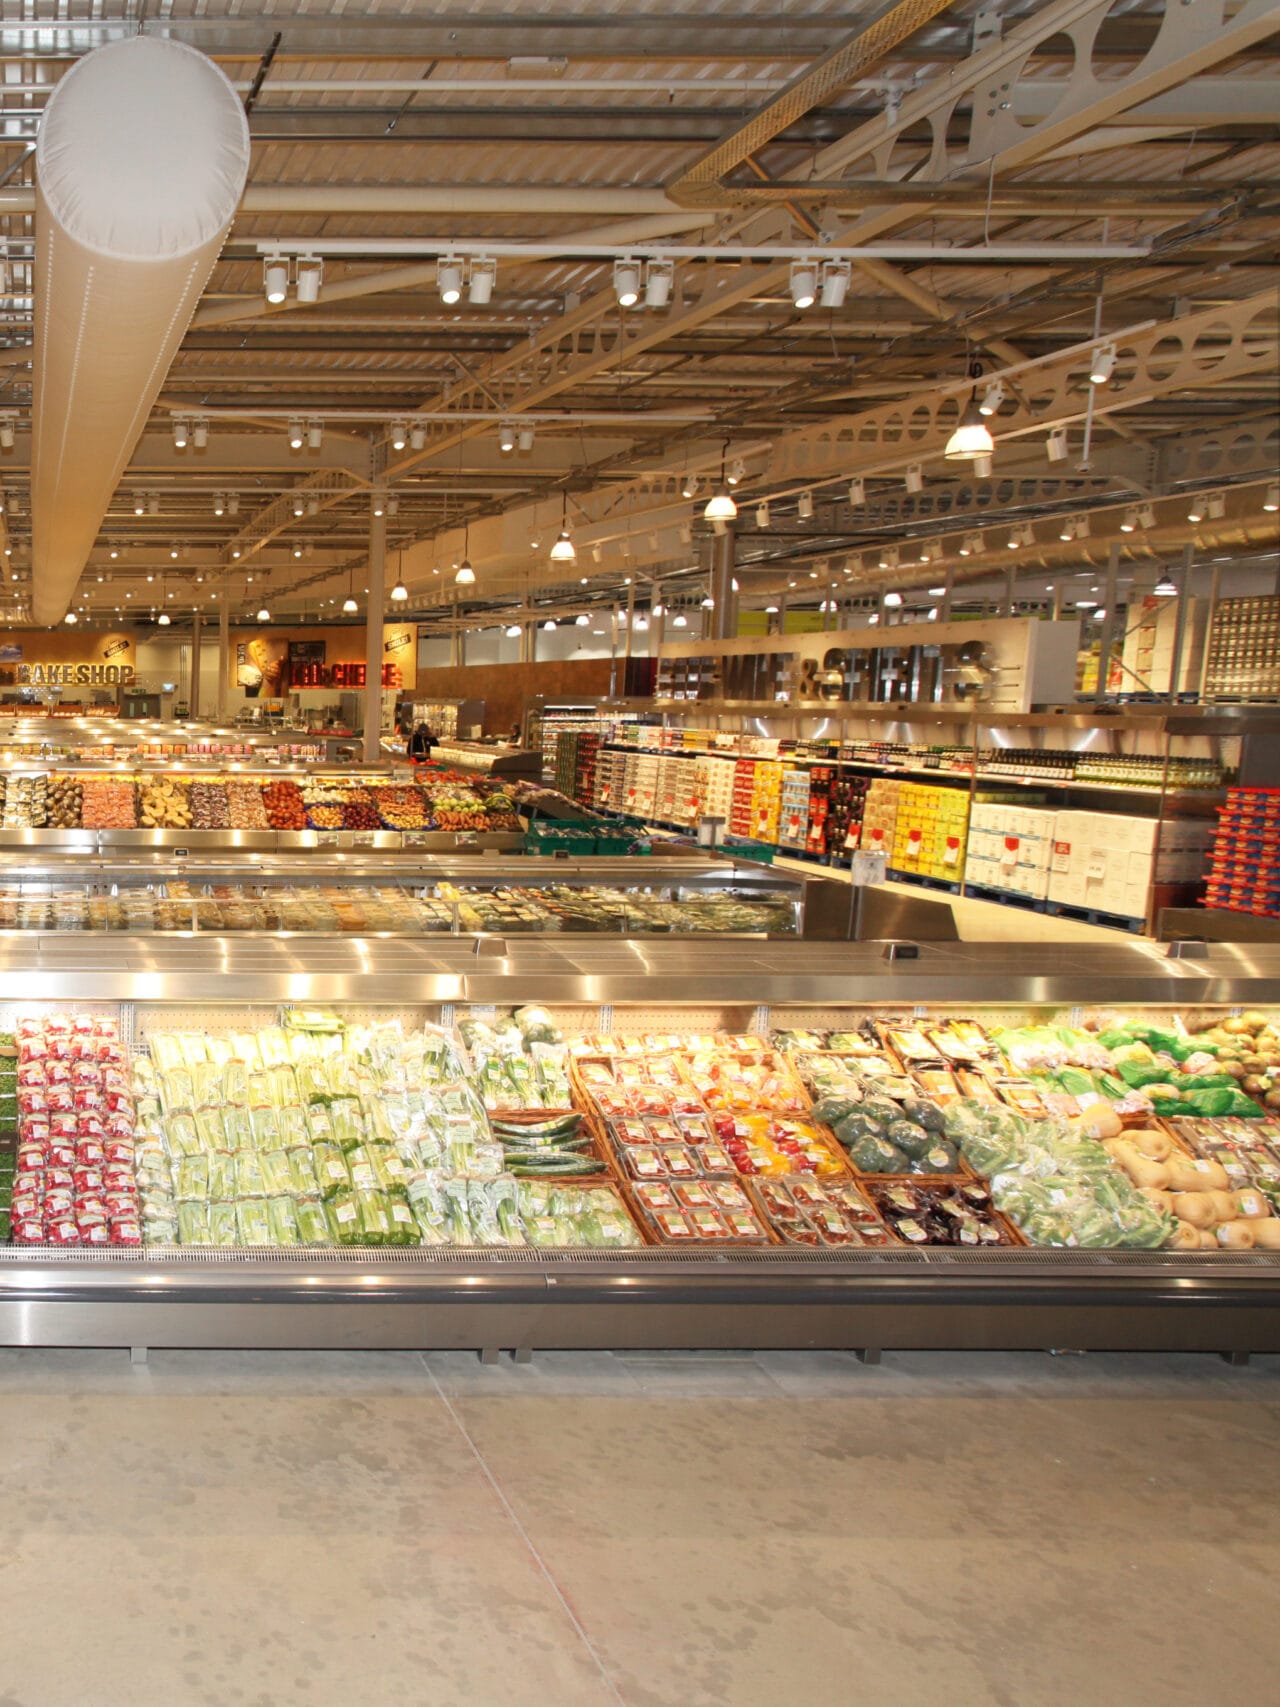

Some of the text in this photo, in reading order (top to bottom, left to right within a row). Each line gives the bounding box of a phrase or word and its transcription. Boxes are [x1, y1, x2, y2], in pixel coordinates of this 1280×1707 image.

[17, 664, 73, 684] BAKE
[76, 664, 134, 684] SHOP
[331, 663, 397, 686] CHEE
[722, 652, 796, 702] WINE
[800, 658, 820, 701] &
[822, 641, 992, 702] SPIRITS
